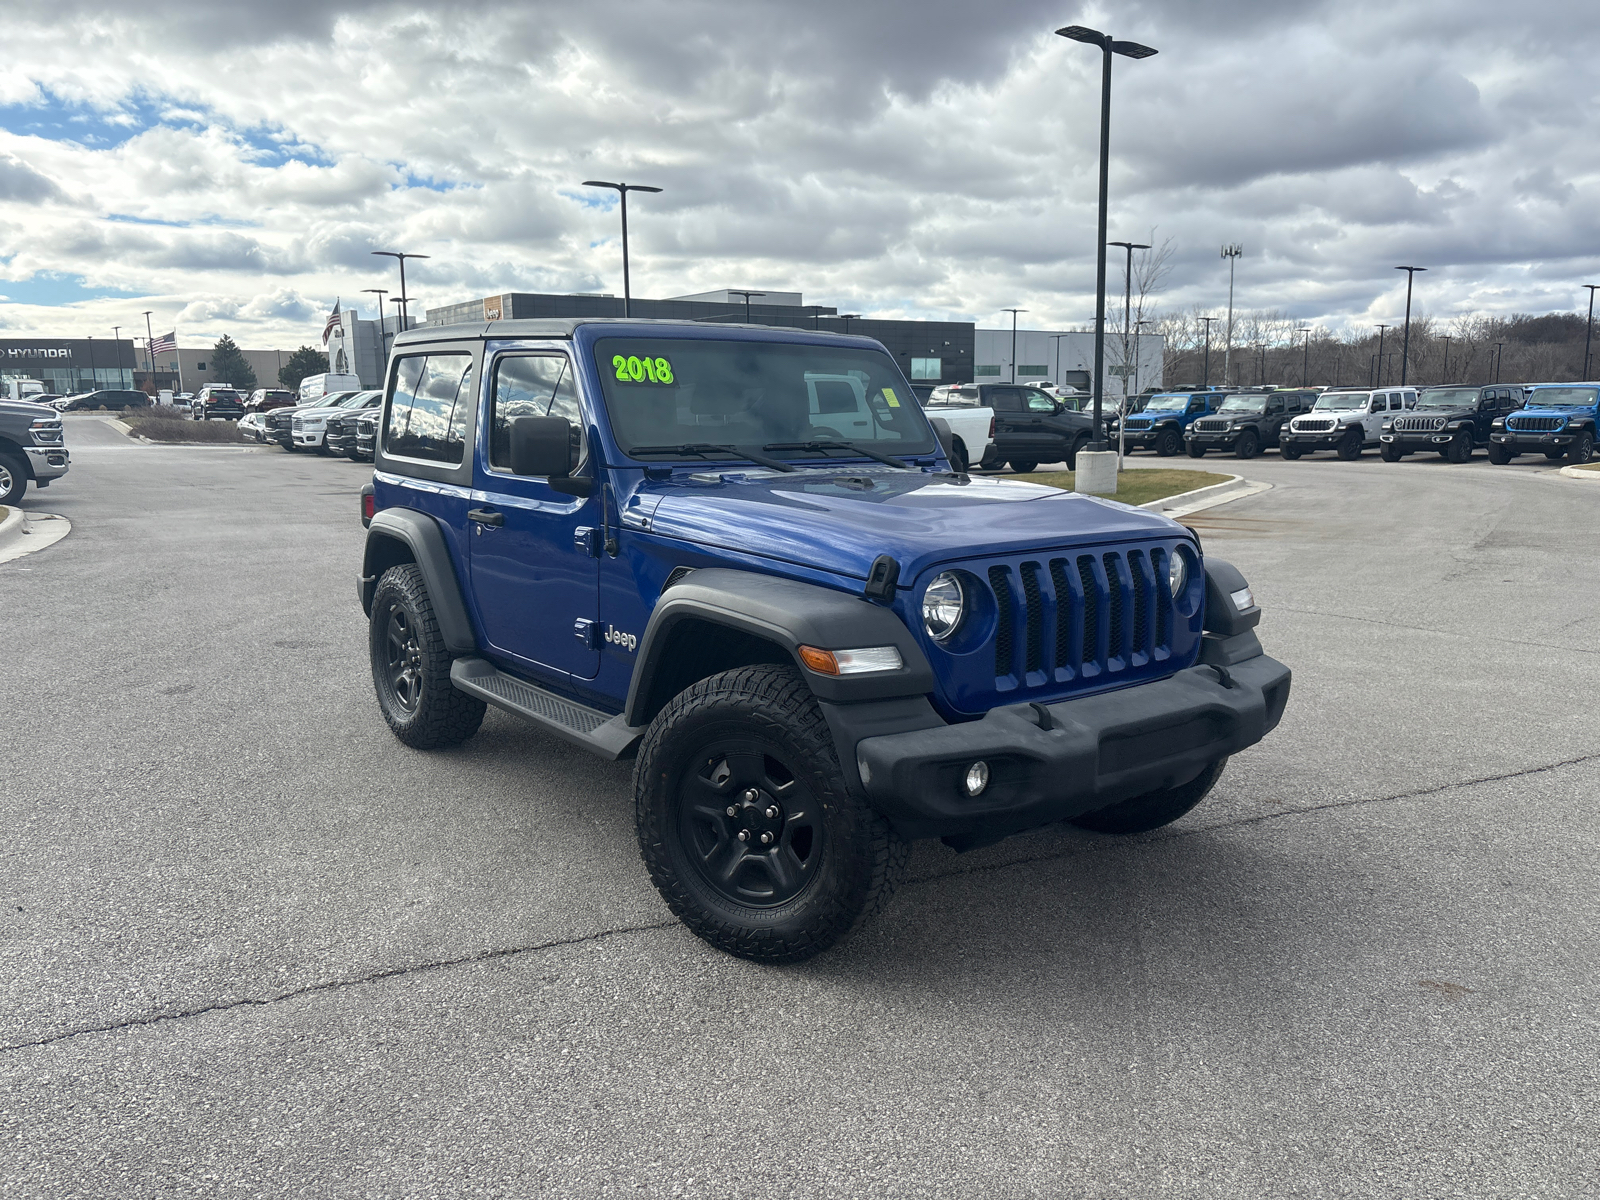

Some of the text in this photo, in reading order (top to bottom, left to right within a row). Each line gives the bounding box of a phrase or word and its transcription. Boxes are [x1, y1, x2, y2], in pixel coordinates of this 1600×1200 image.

[8, 348, 72, 359] HYUNDAI
[612, 354, 674, 384] 2018
[604, 624, 637, 652] Jeep
